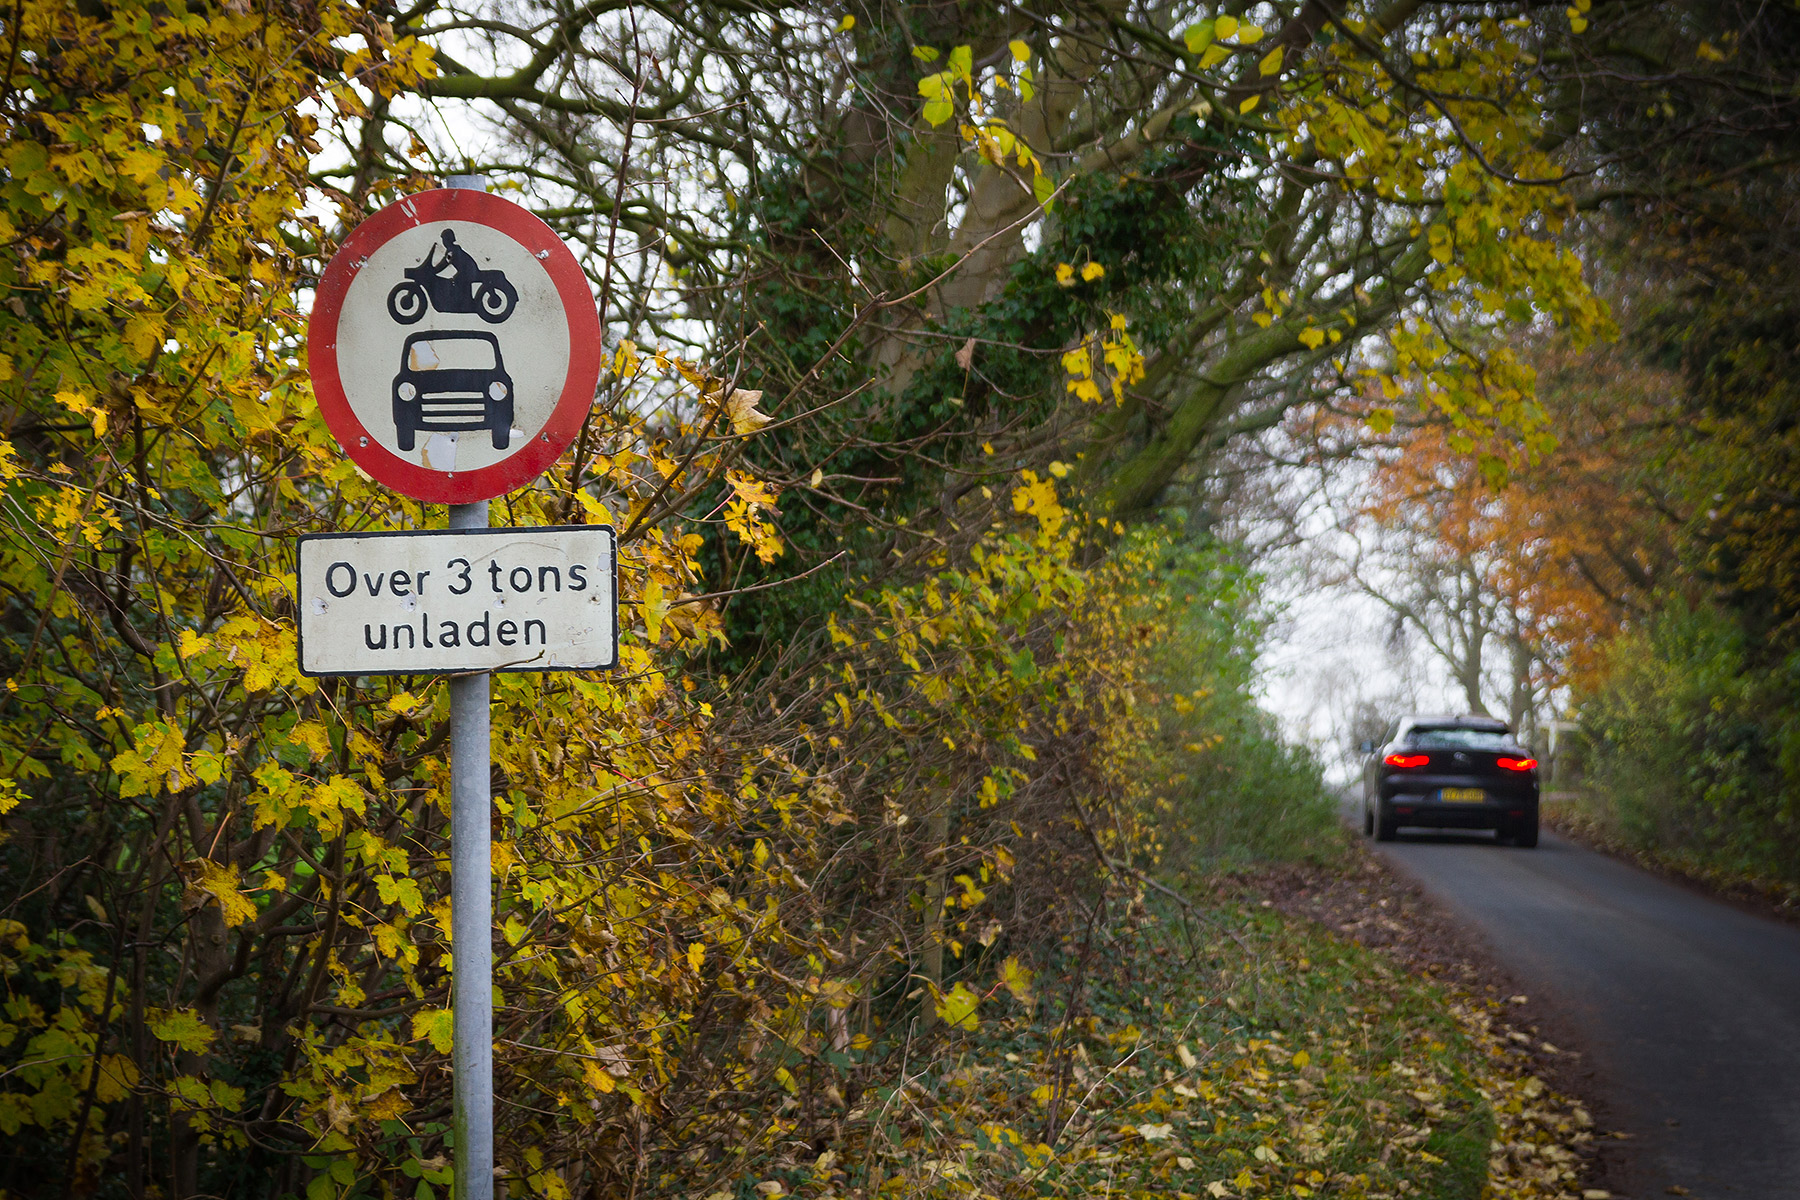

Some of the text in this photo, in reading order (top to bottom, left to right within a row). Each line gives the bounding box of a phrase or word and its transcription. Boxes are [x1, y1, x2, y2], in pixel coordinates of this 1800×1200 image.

[326, 559, 588, 597] Over 3 tons
[364, 611, 546, 650] unladen
